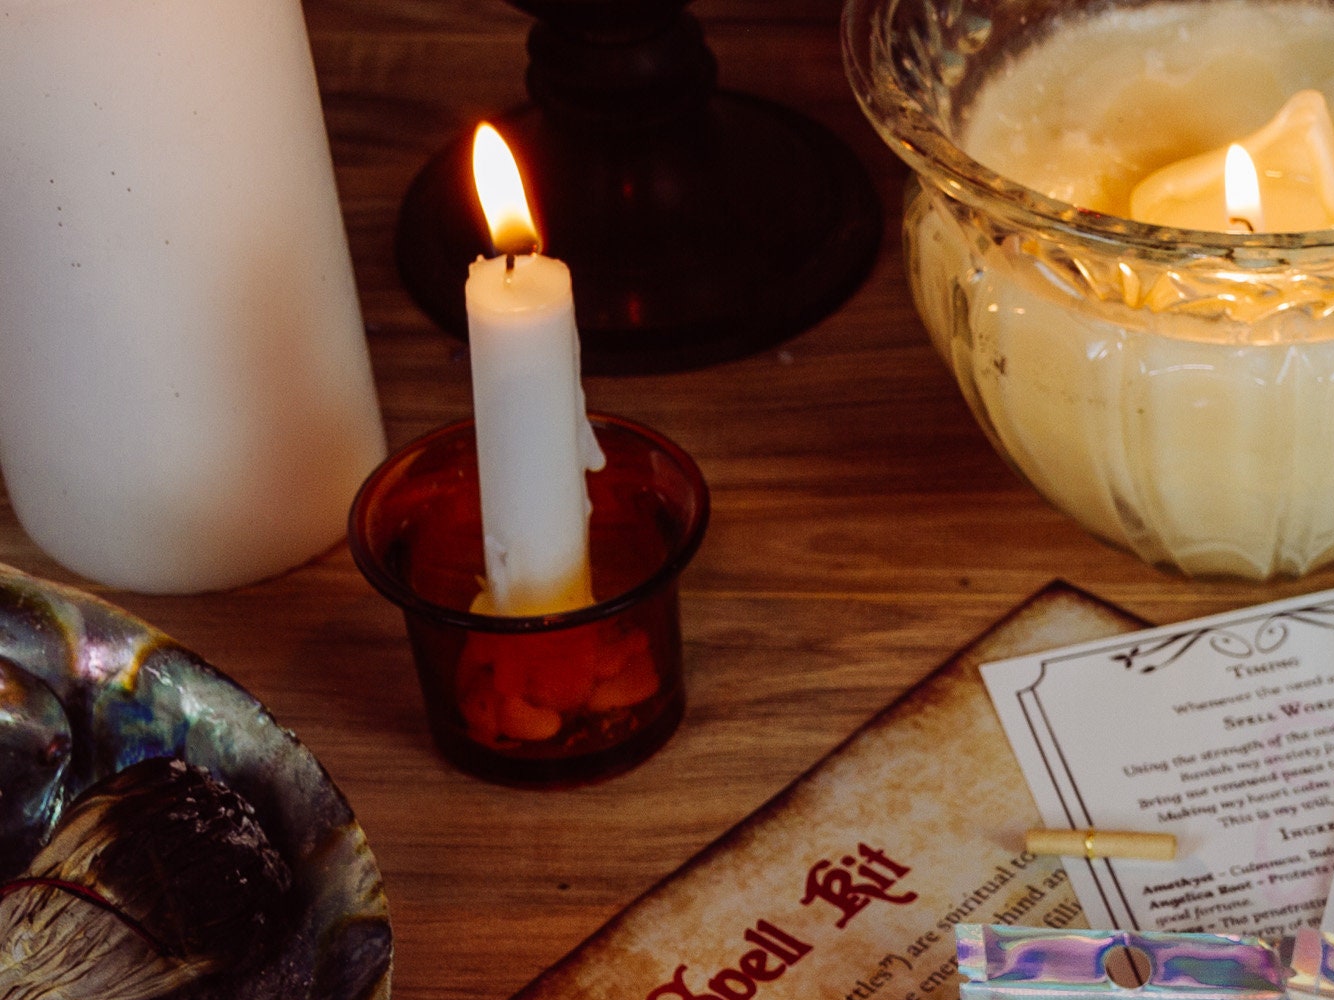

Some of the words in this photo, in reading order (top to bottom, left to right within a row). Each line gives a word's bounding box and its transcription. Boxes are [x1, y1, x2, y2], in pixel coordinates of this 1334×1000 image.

[1222, 712, 1277, 730] SPELL
[1122, 760, 1170, 778] Using
[1172, 754, 1198, 767] the
[1200, 740, 1265, 761] strength
[1267, 734, 1282, 748] of
[1138, 793, 1183, 810] Bring
[1158, 803, 1217, 823] Making
[801, 842, 919, 929] Kit
[1142, 872, 1215, 896] Amethyst
[1149, 889, 1215, 911] Angelica
[1218, 880, 1252, 895] Root
[1222, 913, 1250, 929] The
[907, 930, 941, 959] are
